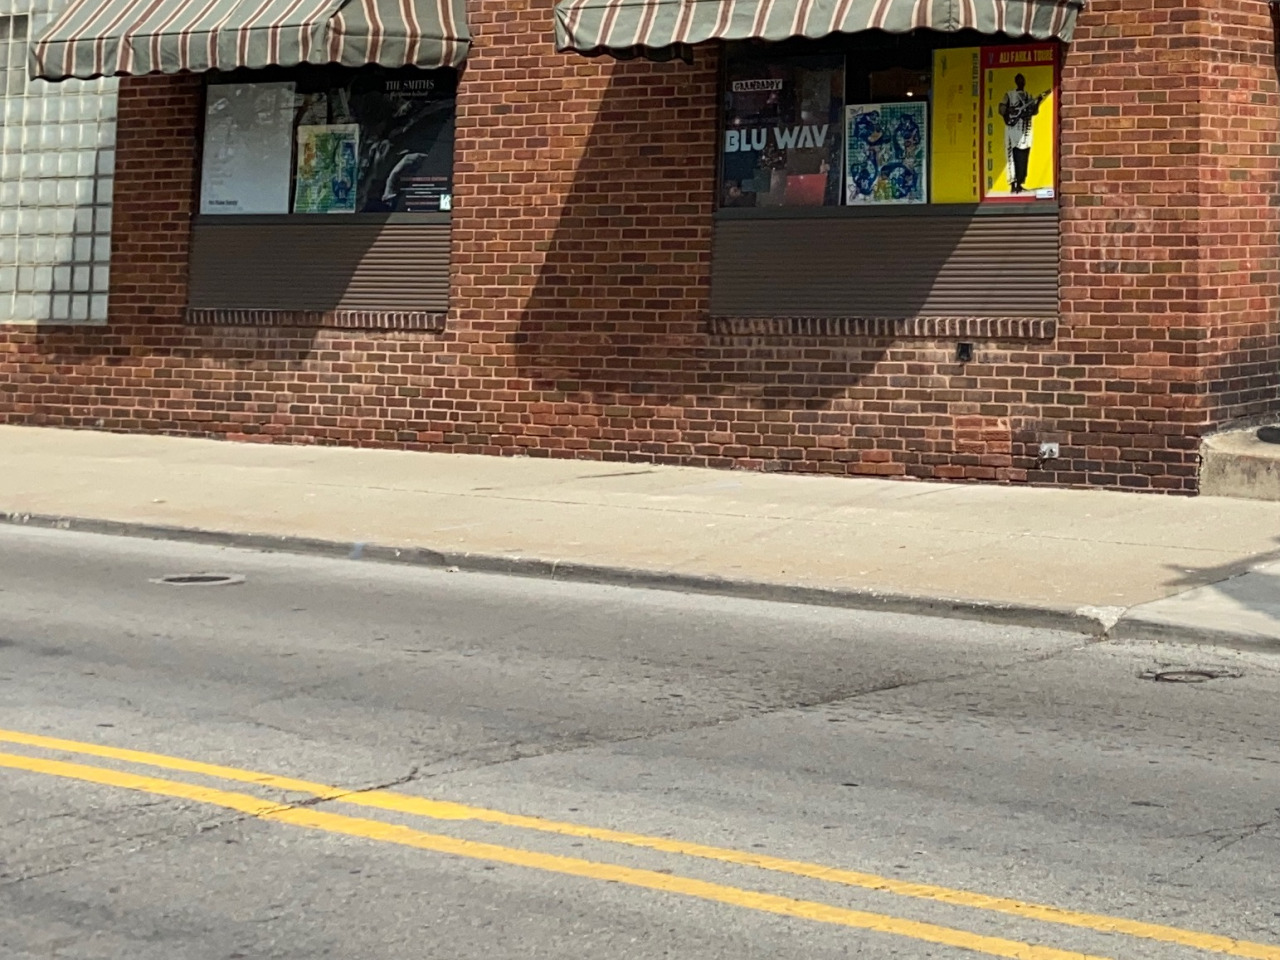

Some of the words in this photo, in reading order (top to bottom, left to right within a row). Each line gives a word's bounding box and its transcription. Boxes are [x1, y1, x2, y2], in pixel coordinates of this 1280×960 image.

[734, 80, 780, 91] GRANDADDY
[725, 128, 767, 152] BLU
[773, 124, 829, 150] WAV
